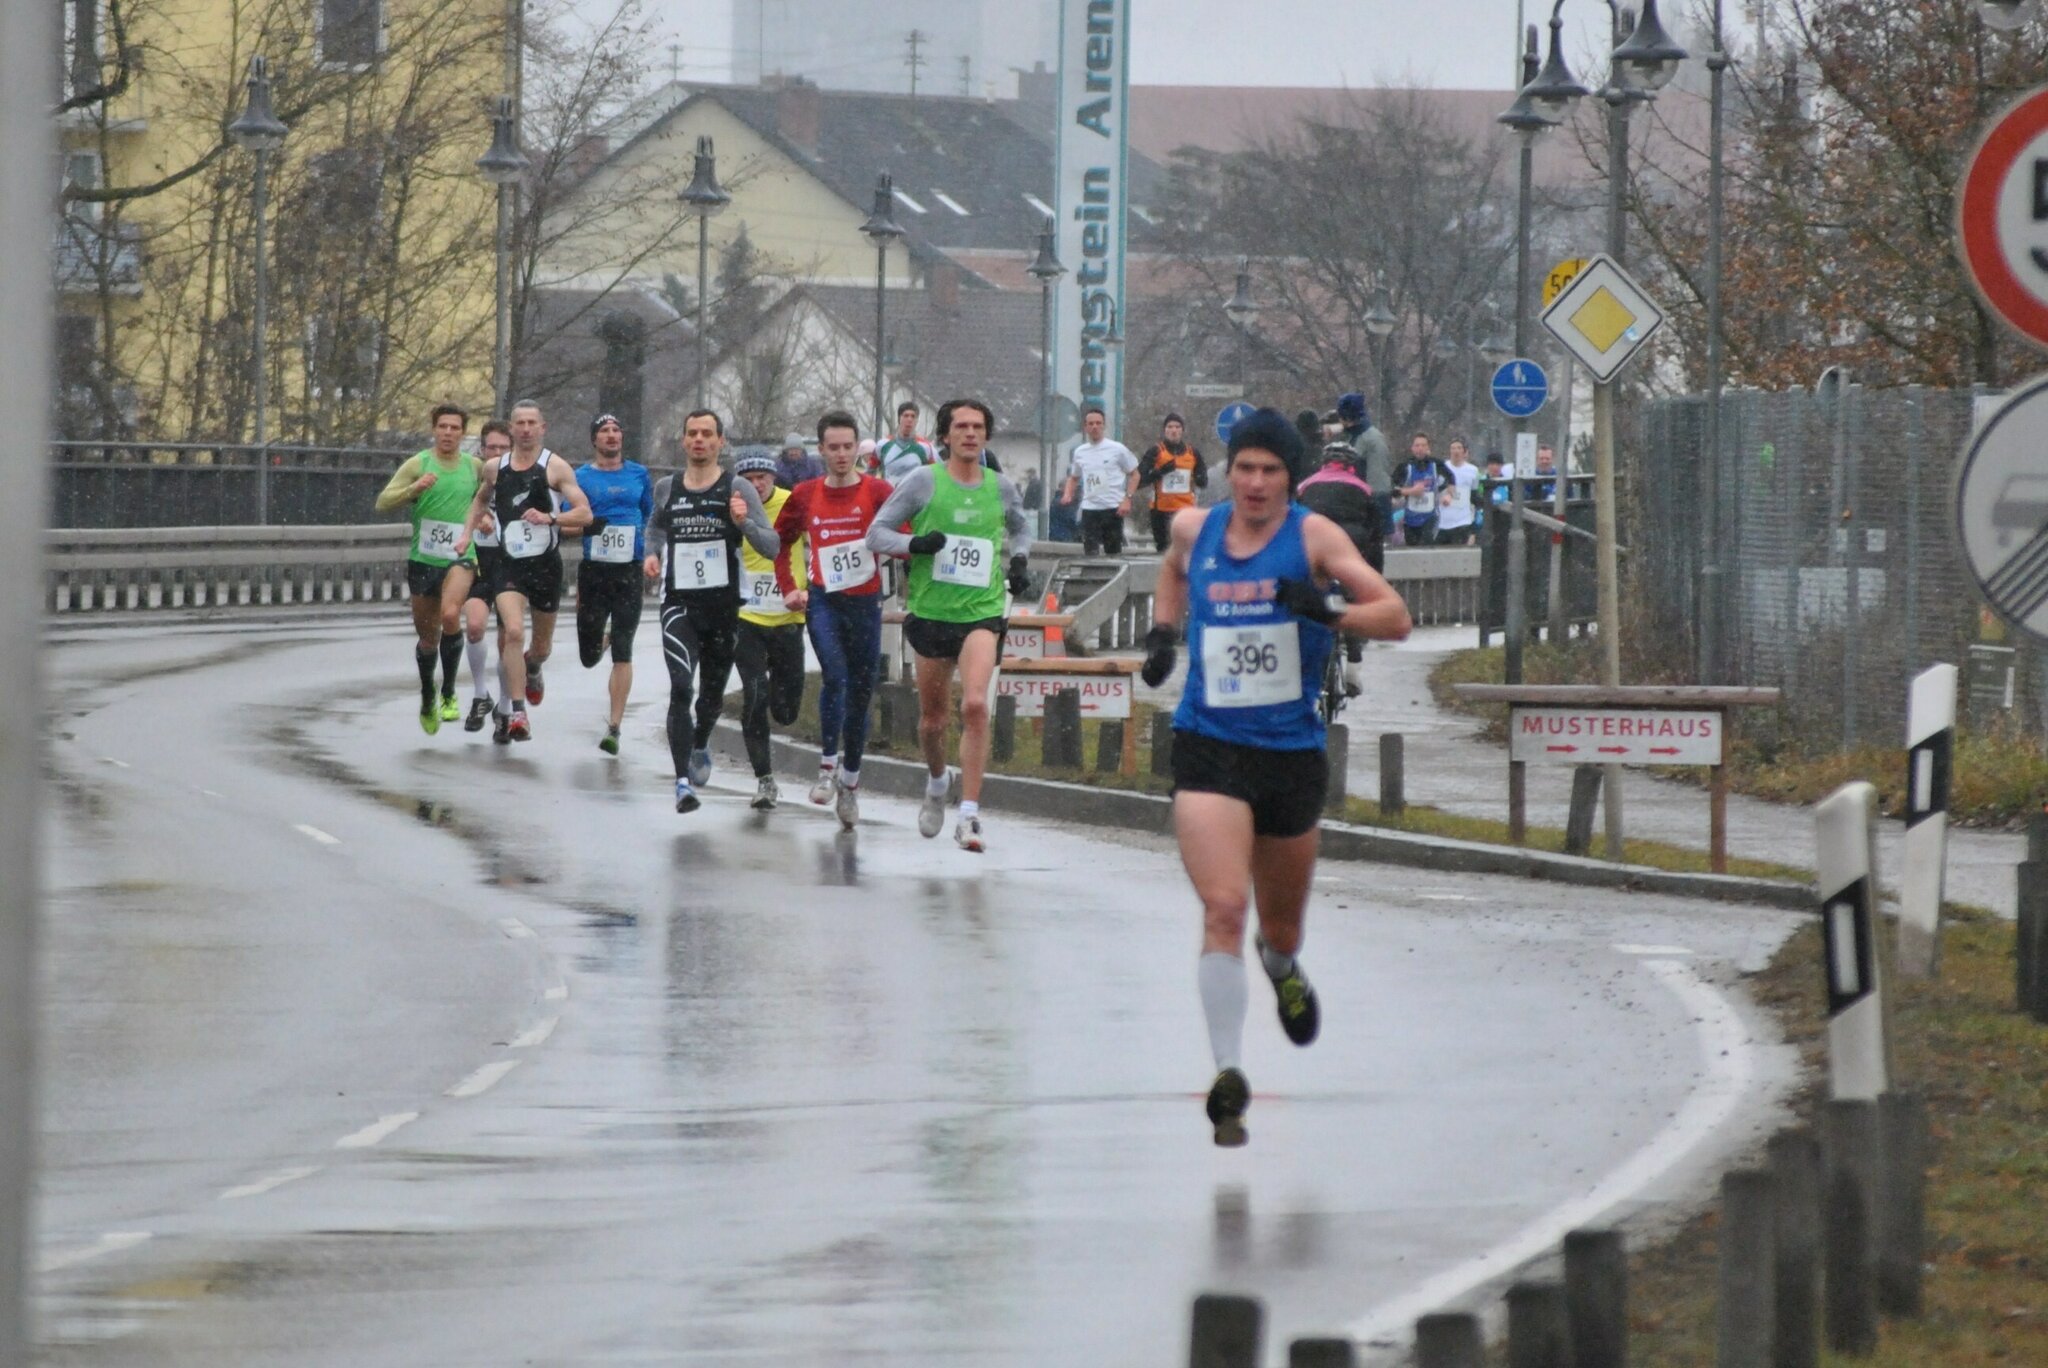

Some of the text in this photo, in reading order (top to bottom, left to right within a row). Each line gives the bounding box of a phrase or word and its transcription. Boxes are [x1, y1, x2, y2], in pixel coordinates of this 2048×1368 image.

[430, 527, 454, 545] 534
[523, 527, 533, 542] 5
[602, 533, 625, 548] 916
[832, 550, 861, 572] 815
[951, 546, 980, 567] 199
[695, 560, 704, 578] 8
[754, 580, 781, 597] 674
[1226, 643, 1278, 675] 396
[1522, 715, 1712, 738] MUSTERHAUS
